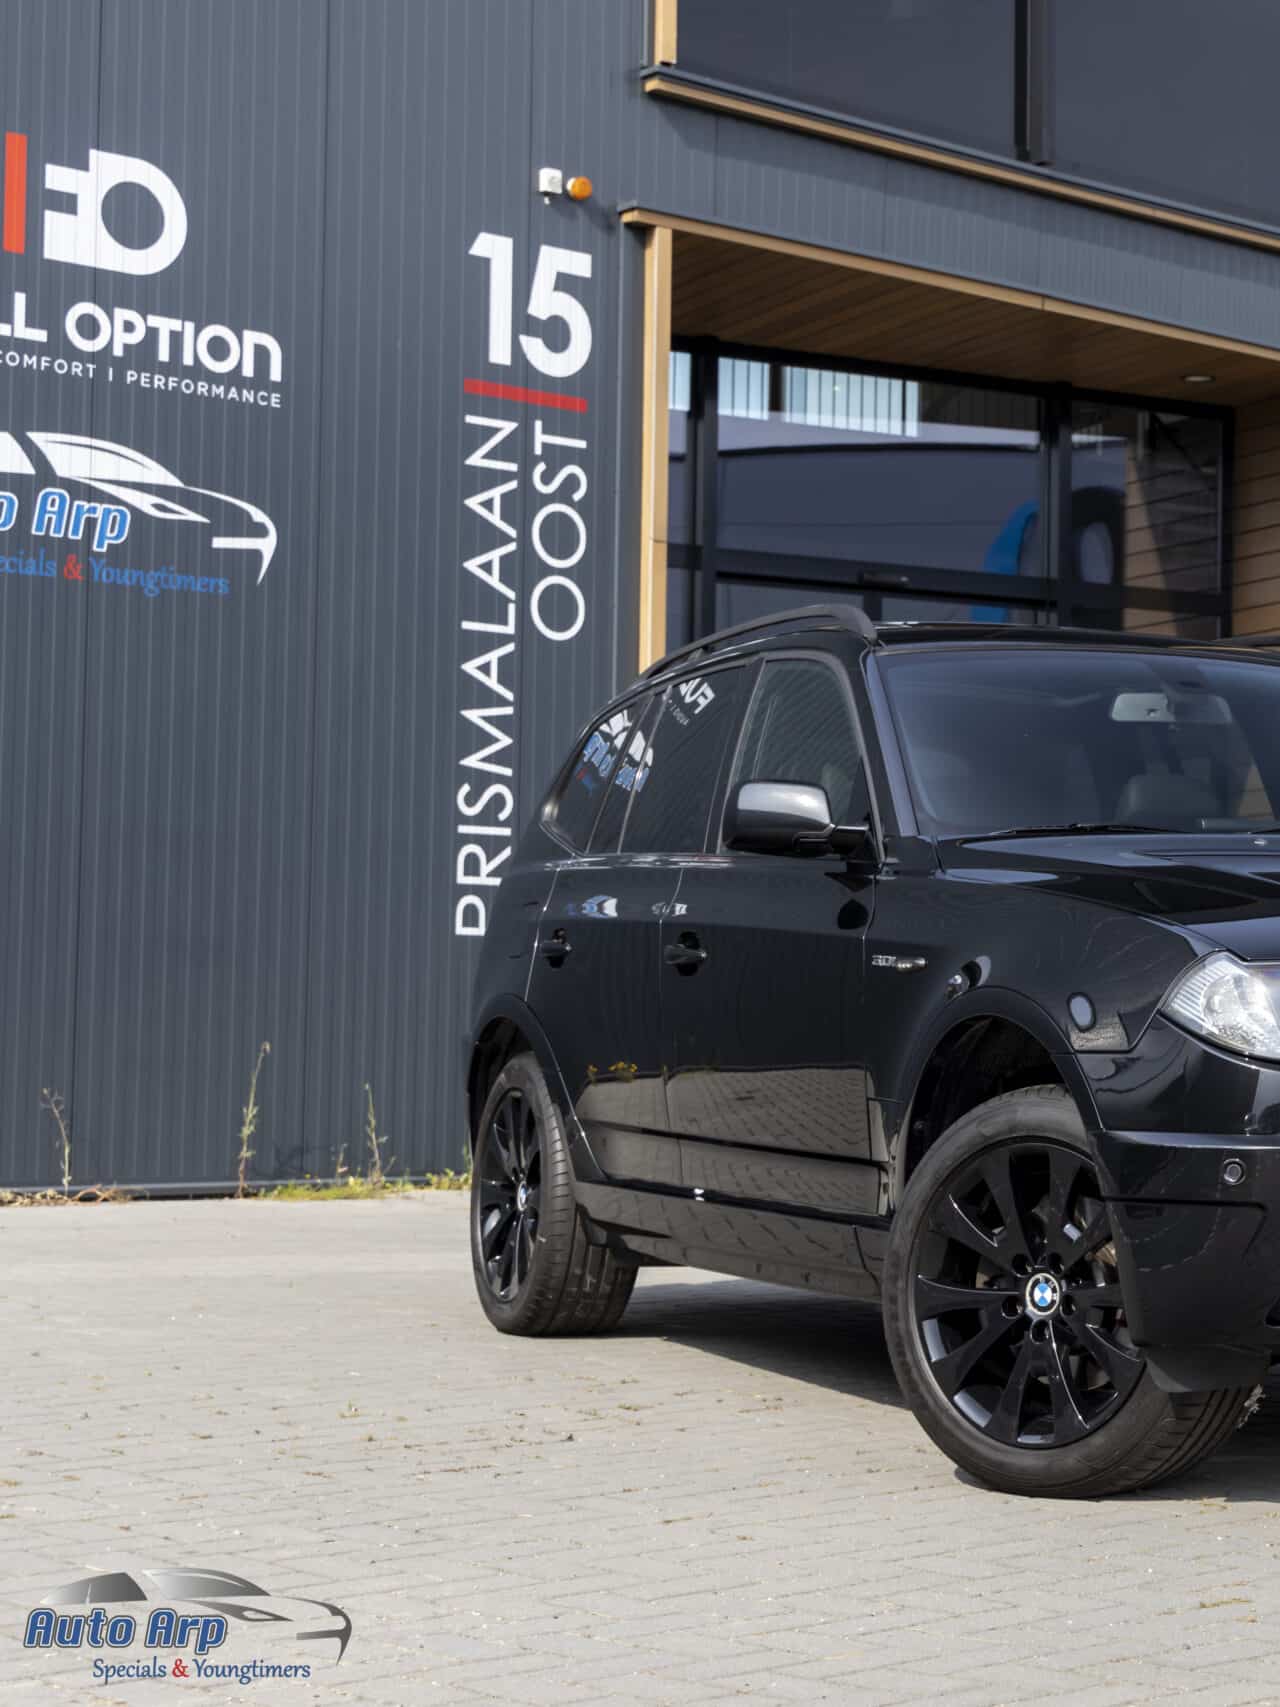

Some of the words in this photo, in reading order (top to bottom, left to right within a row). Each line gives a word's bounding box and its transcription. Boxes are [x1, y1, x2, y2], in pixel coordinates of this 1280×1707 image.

[467, 231, 593, 379] 15
[126, 370, 282, 408] PERFORMANCE
[31, 487, 131, 553] Arp
[530, 420, 588, 642] OOST
[63, 553, 84, 581] &
[89, 556, 230, 597] Youngtimers
[455, 414, 518, 936] PRISMALAAN
